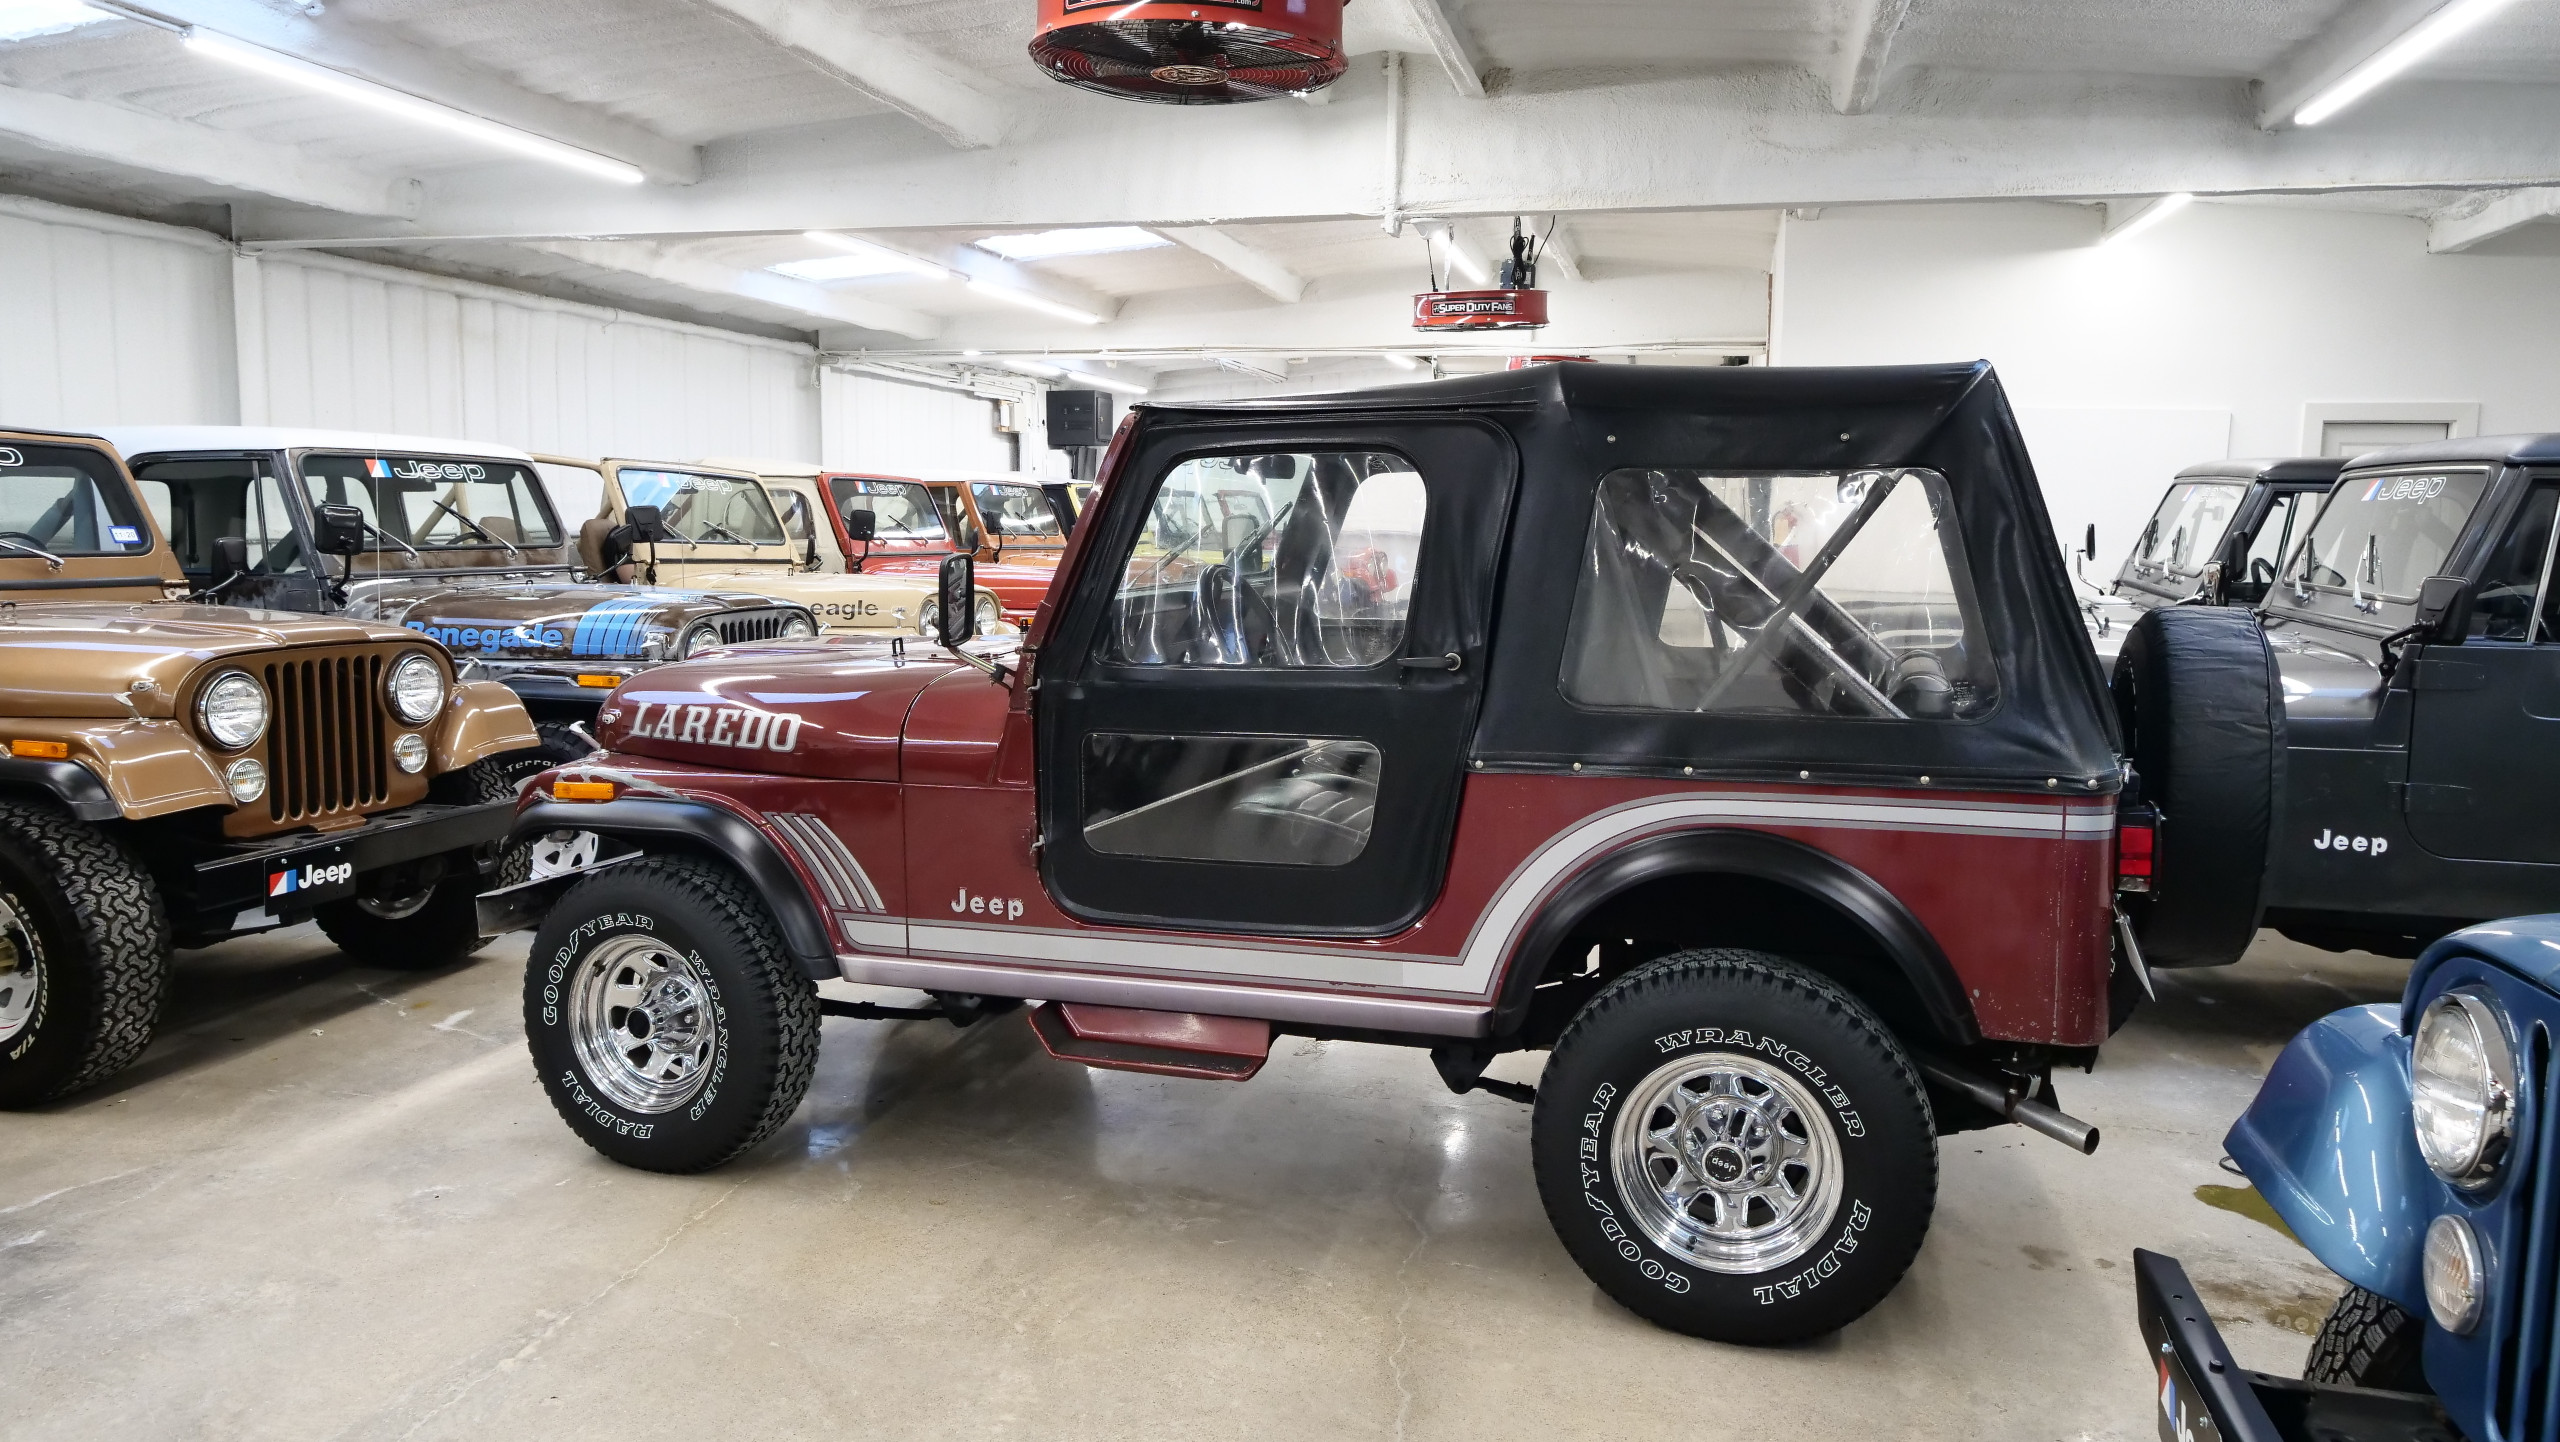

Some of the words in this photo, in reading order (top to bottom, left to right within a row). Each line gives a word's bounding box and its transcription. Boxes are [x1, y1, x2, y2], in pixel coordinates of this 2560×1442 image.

[1440, 303, 1465, 313] SUPER
[1466, 302, 1490, 312] DUTY
[1491, 301, 1513, 311] FANS
[393, 460, 486, 483] Jeep
[676, 476, 732, 495] Jeep
[867, 482, 906, 498] Jeep
[999, 485, 1029, 499] Jeep
[2377, 476, 2447, 505] Jeep
[810, 600, 879, 620] eagle
[629, 700, 803, 753] LAREDO
[2313, 828, 2388, 856] Jeep
[298, 862, 352, 889] Jeep
[951, 886, 1024, 921] Jeep
[690, 949, 730, 1121] WRANGLER
[1655, 1028, 1866, 1138] WRANGLER
[561, 1069, 655, 1139] RADIAL
[1753, 1200, 1872, 1305] RADIAL
